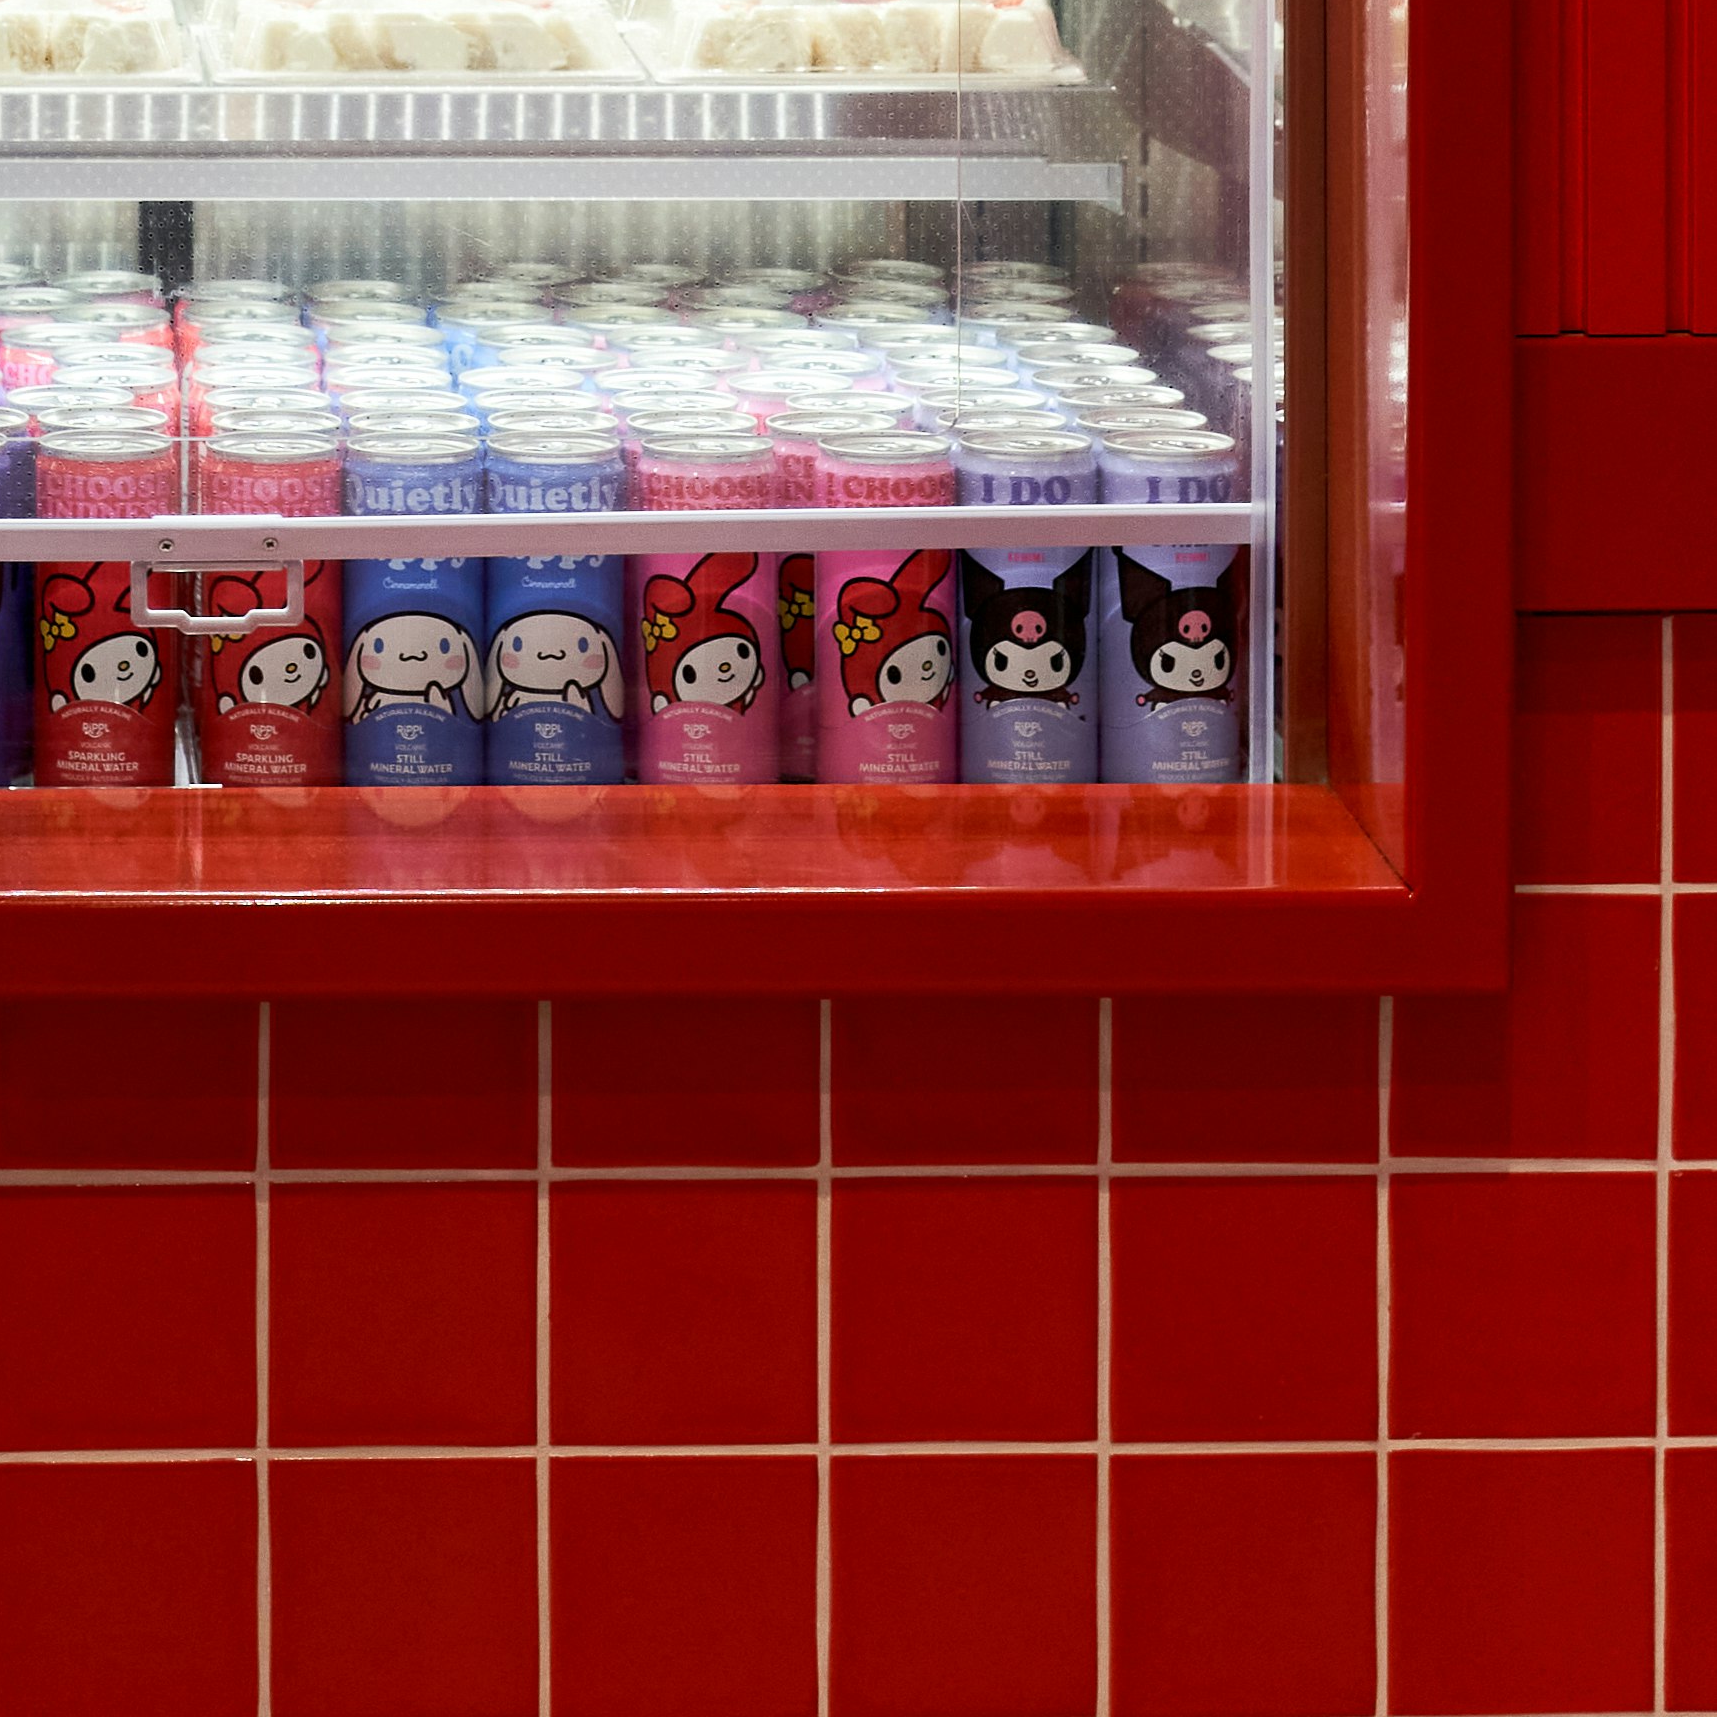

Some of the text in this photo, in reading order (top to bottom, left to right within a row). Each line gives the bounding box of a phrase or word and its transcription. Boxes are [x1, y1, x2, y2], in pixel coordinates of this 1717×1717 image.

[489, 473, 618, 513] Quietly
[981, 474, 1071, 505] I DO
[1146, 473, 1231, 503] I DO
[347, 474, 479, 515] Quietly
[67, 750, 126, 762] SPARKLING
[235, 752, 294, 764] SPARKLING
[396, 754, 425, 764] STILL
[534, 752, 564, 762] STILL
[683, 753, 712, 763] STILL
[887, 753, 916, 763] STILL
[1014, 751, 1043, 761] STILL
[1181, 751, 1209, 760] STILL
[56, 760, 139, 772] MINERAL WATER
[224, 761, 307, 774] MINERAL WATER
[370, 762, 453, 774] MINERAL WATER
[508, 760, 591, 772] MINERAL WATER
[658, 761, 740, 773] MINERAL WATER
[859, 762, 907, 773] MINERAL
[986, 760, 1033, 771] MINERAL
[1152, 761, 1200, 771] MINERAL
